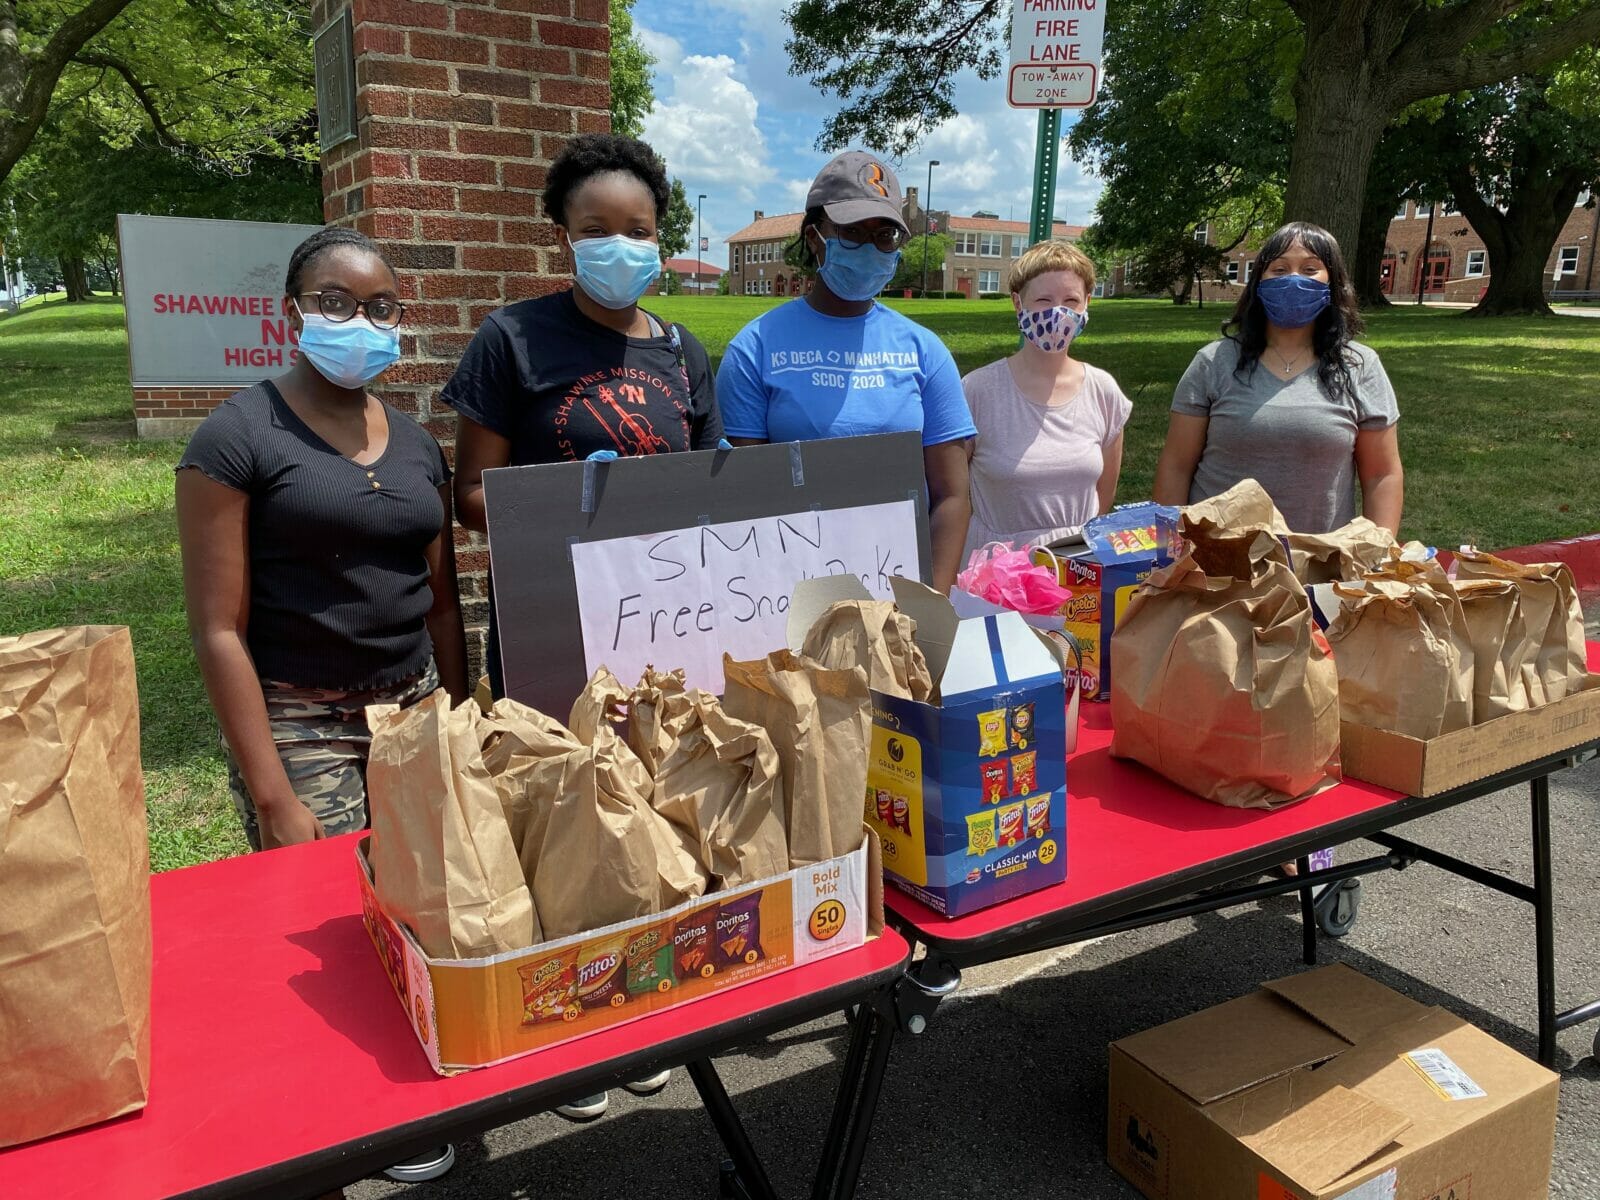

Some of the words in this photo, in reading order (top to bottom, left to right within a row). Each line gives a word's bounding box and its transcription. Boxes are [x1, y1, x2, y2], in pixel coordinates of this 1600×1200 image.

[1035, 20, 1079, 37] FIRE
[1030, 44, 1081, 61] LANE
[1022, 72, 1084, 81] TOW-AWAY
[1036, 89, 1067, 97] ZONE
[153, 294, 274, 316] SHAWNEE
[225, 348, 283, 366] HIGH
[771, 352, 787, 368] KS
[791, 350, 823, 365] DECA
[844, 351, 918, 367] MANHATTAN
[812, 372, 845, 388] SCDC
[852, 374, 885, 389] 2020
[555, 370, 608, 425] SHAWNEE
[610, 368, 672, 398] MISSION
[1069, 560, 1096, 581] Doritos
[1066, 594, 1097, 619] Cheetos
[613, 593, 715, 651] Free
[879, 759, 895, 771] GRAB
[905, 769, 916, 779] GO
[884, 839, 896, 855] 28
[1041, 845, 1054, 858] 28
[985, 855, 1020, 873] CLASSIC
[1022, 849, 1037, 861] MIX
[812, 866, 840, 885] Bold
[816, 882, 838, 897] Mix
[716, 911, 750, 930] Doritos
[817, 906, 839, 927] 50
[675, 925, 707, 945] Doritos
[818, 924, 839, 935] Singles
[578, 953, 617, 987] Fritos
[612, 995, 623, 1005] 10
[565, 1009, 577, 1019] 16
